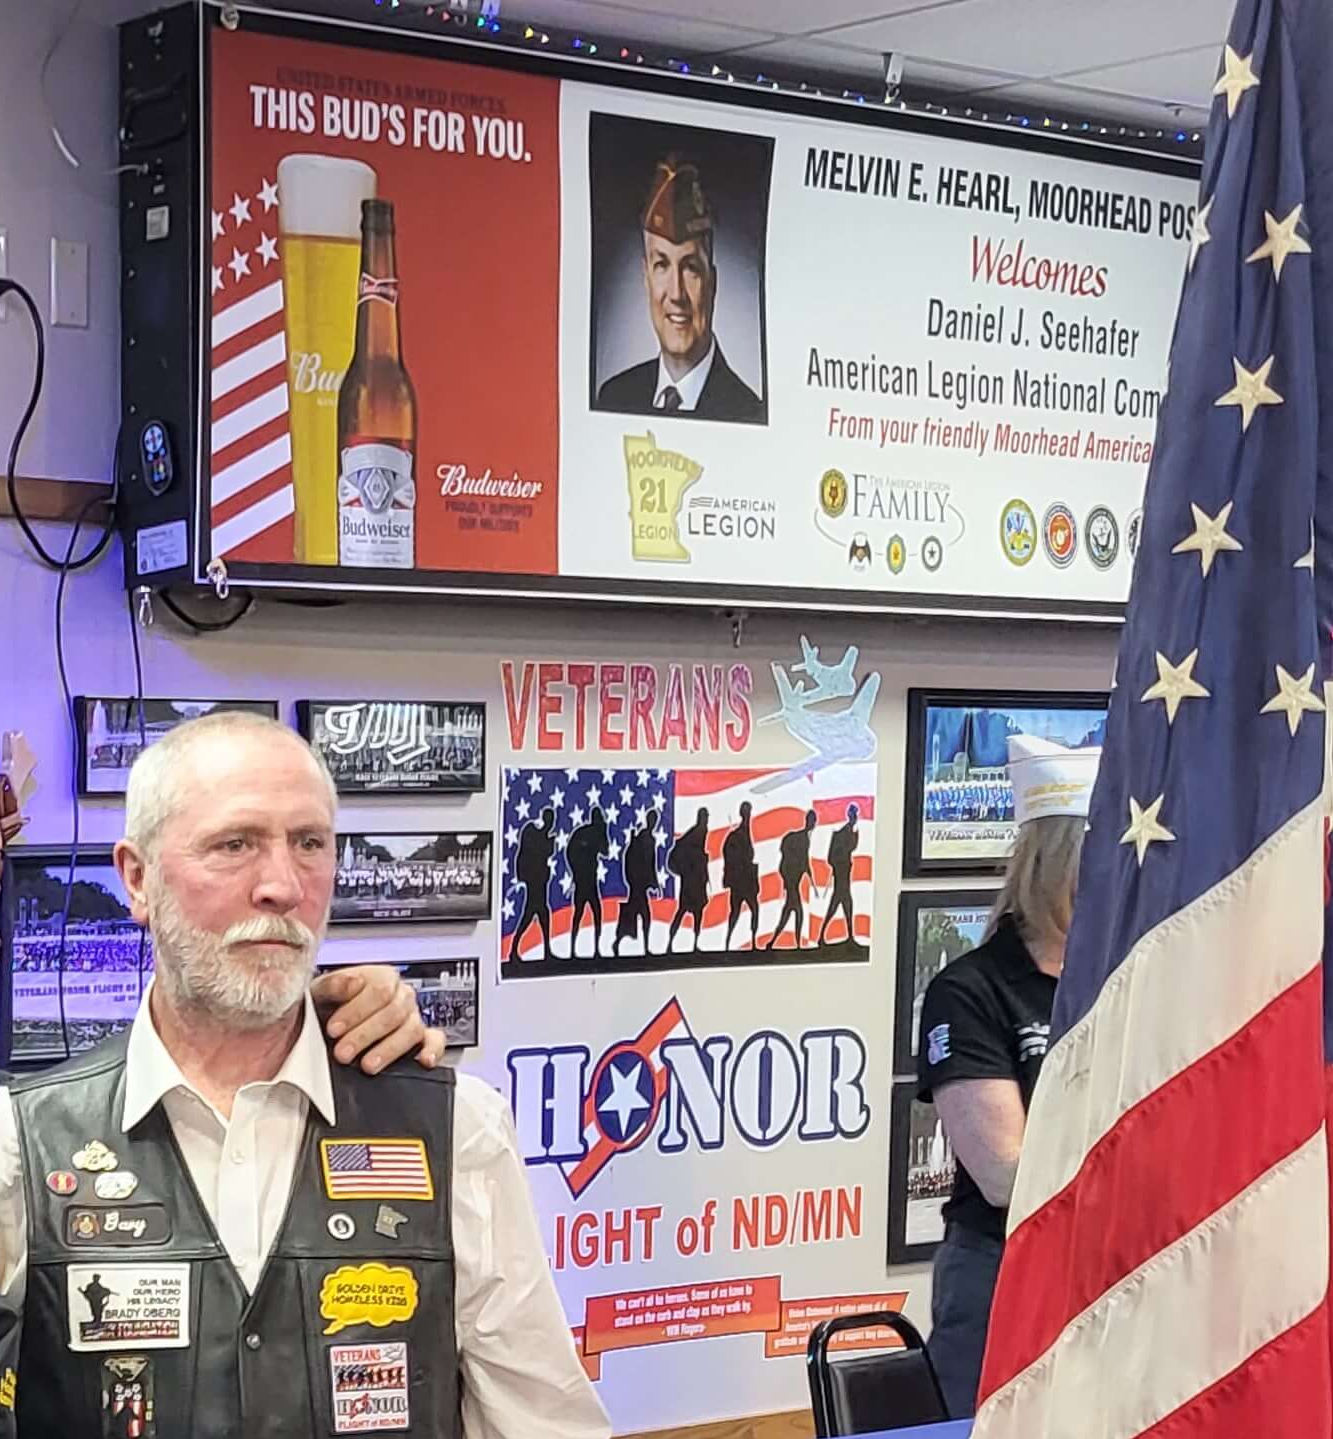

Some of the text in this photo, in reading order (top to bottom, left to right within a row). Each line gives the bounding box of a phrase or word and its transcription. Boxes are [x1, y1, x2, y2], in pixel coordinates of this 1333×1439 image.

[249, 85, 532, 162] THIS BUD'S FOR YOU.
[804, 147, 900, 199] MELVIN
[908, 163, 929, 203] E.
[936, 167, 1021, 223] HEARL,
[1028, 179, 1152, 235] MOORHEAD
[971, 235, 1109, 298] Welcomes
[928, 298, 1139, 358] Daniel J. Seehafer
[807, 347, 918, 398] American
[928, 361, 1004, 411] Legion
[1014, 369, 1106, 417] National
[828, 408, 1152, 464] From your friendly Moorhead America
[436, 464, 542, 498] Budweiser
[639, 477, 668, 513] 21
[713, 498, 777, 512] AMERICAN
[852, 473, 951, 524] FAMILY
[343, 515, 411, 540] Budweiser
[688, 512, 776, 540] LEGION
[501, 661, 753, 753] VETERANS
[506, 1028, 871, 1165] HONOR
[103, 1211, 147, 1238] Gary
[547, 1185, 862, 1270] IGHT of ND/MN
[105, 1309, 141, 1320] BRADY
[333, 1349, 381, 1362] VETERANS
